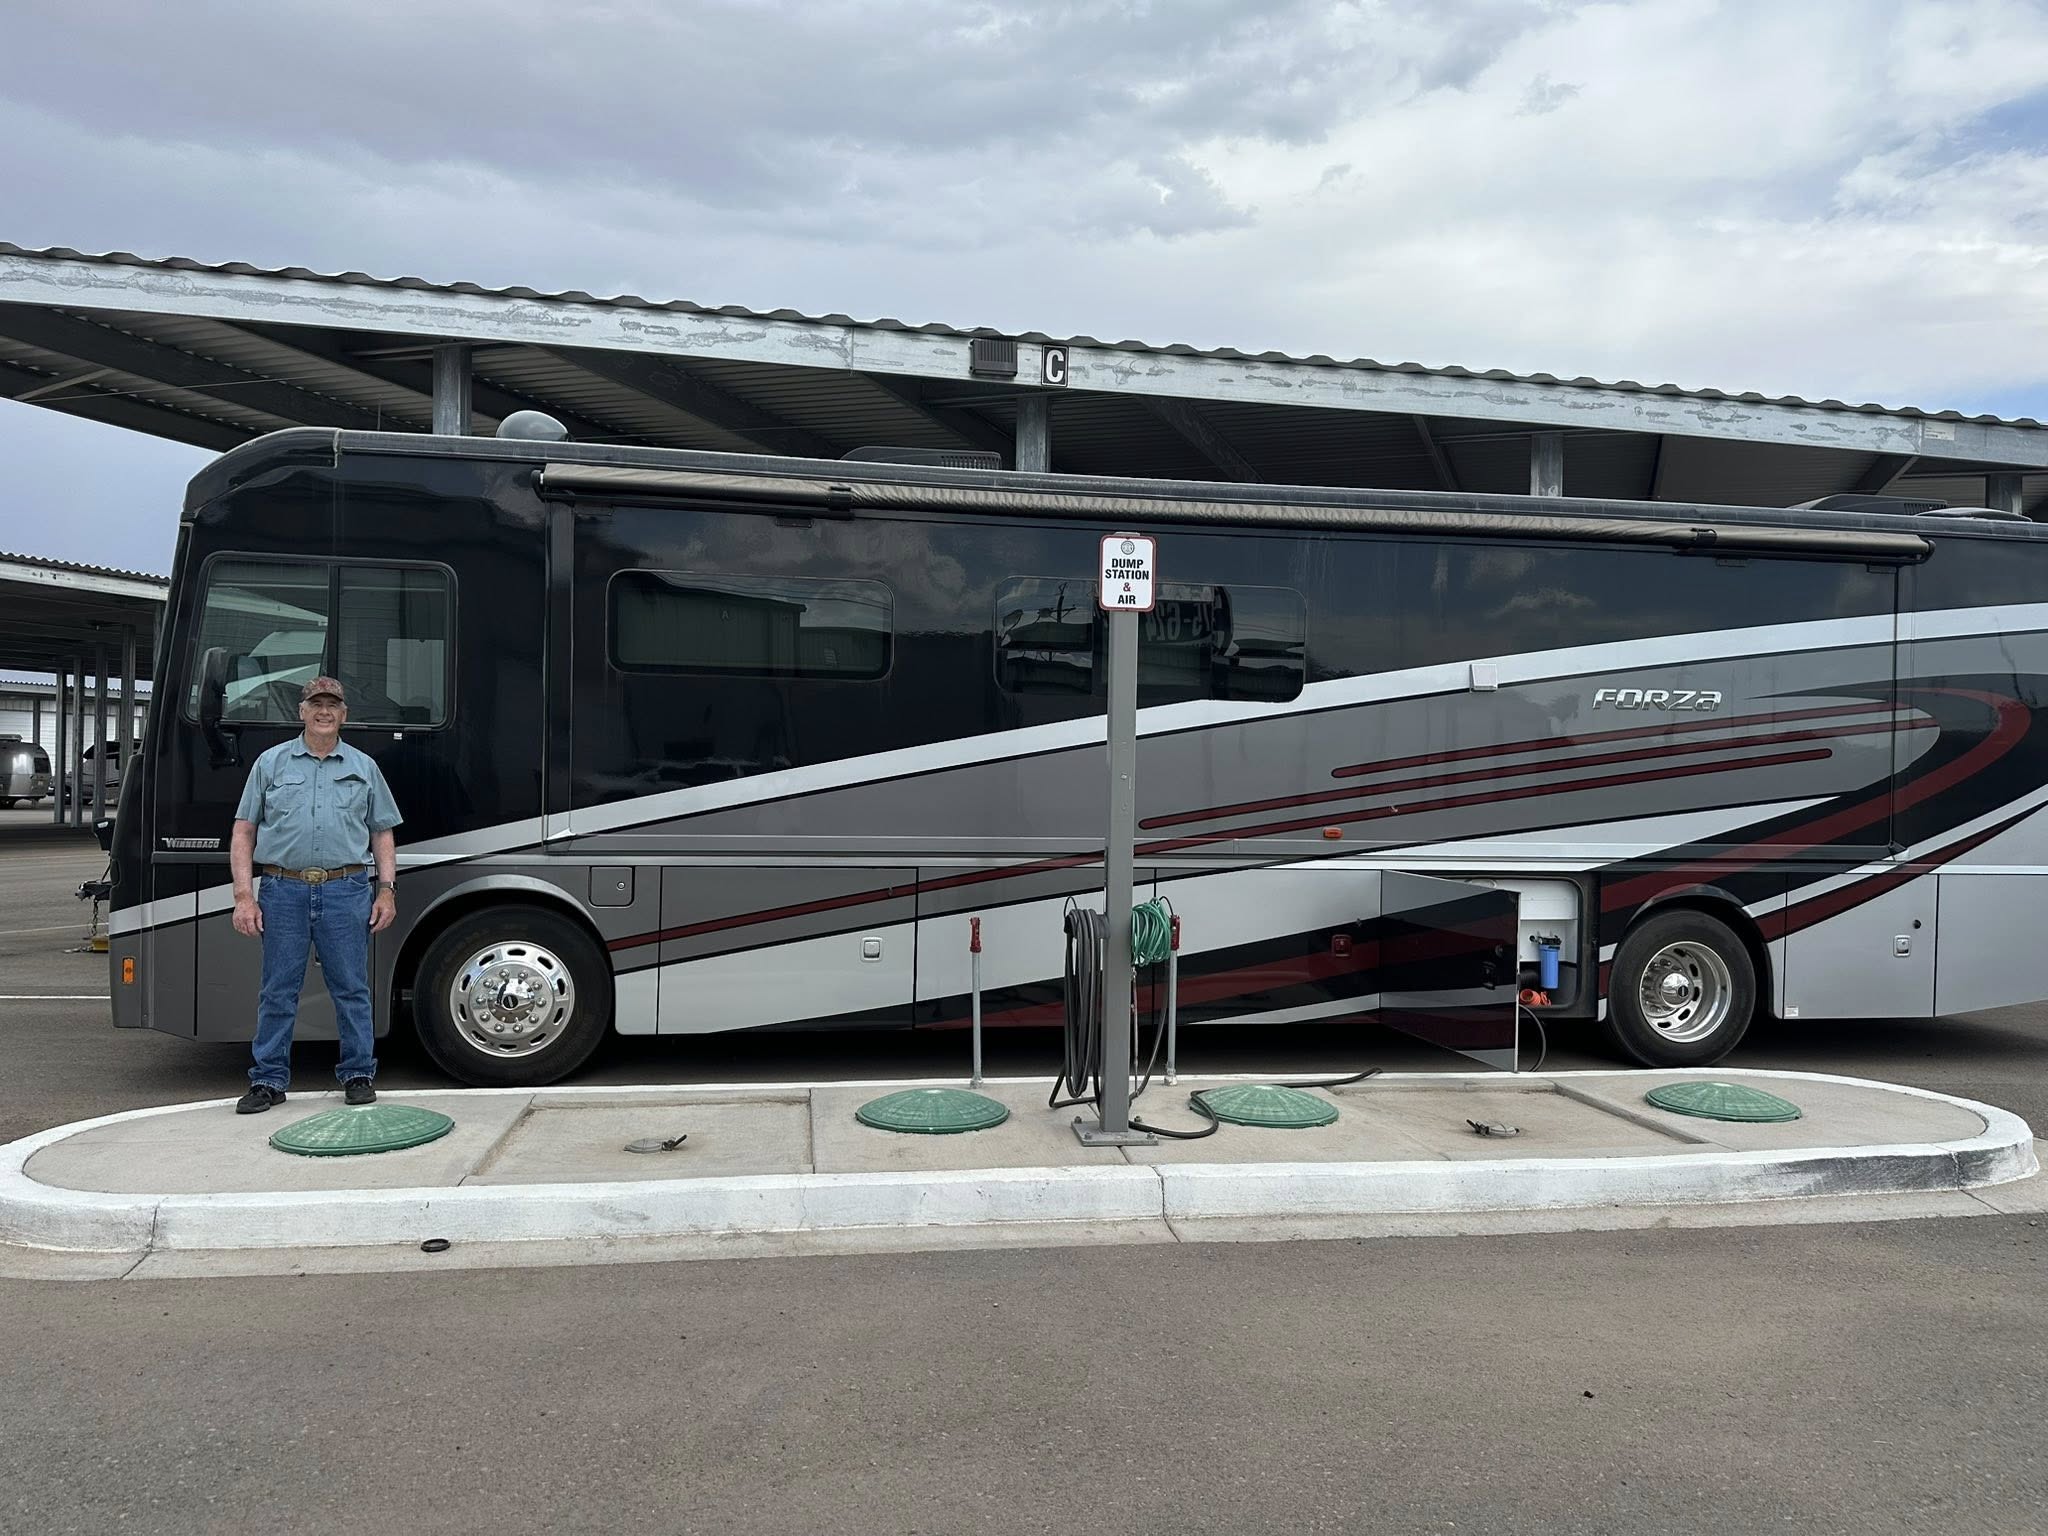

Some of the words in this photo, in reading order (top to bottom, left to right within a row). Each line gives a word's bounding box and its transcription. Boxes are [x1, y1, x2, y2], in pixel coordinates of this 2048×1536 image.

[1046, 349, 1064, 382] C
[1112, 558, 1143, 568] DUMP
[1105, 569, 1149, 580] STATION
[1123, 582, 1131, 592] &
[1118, 595, 1136, 604] AIR
